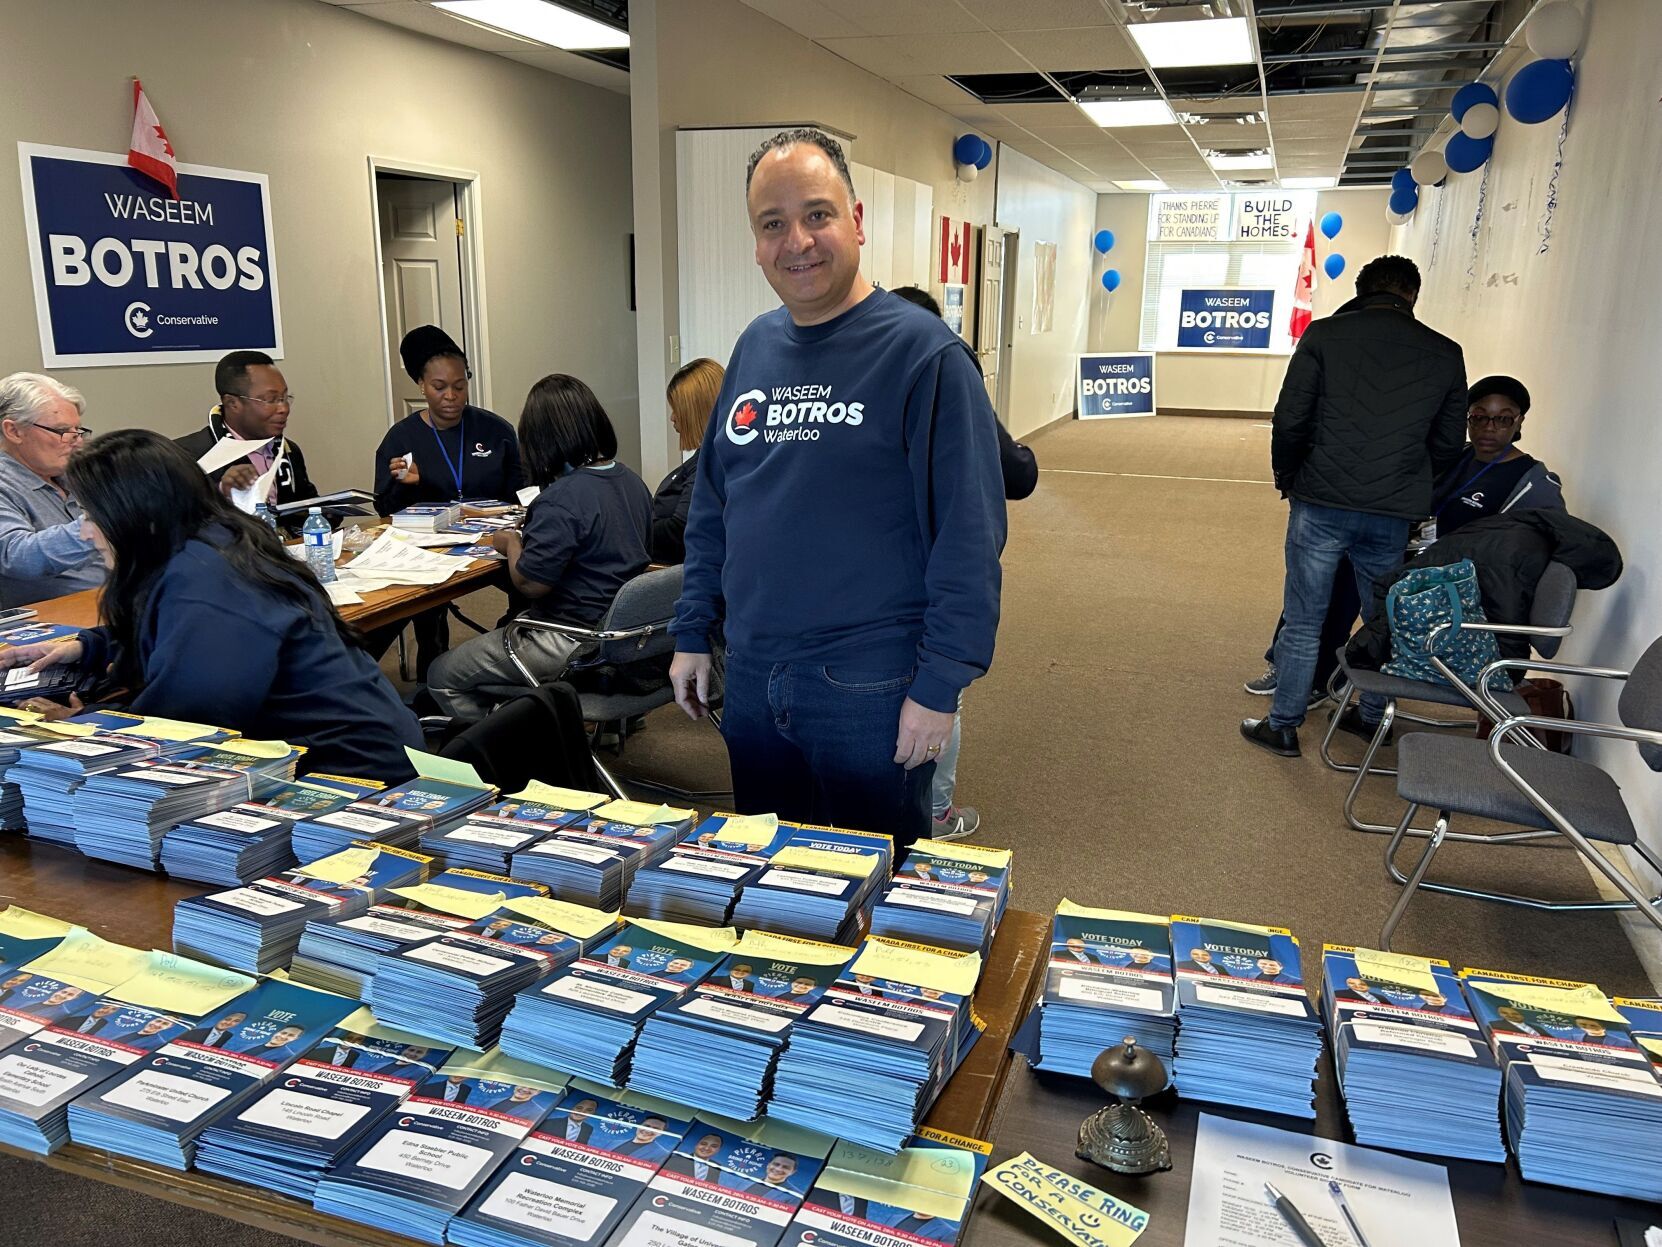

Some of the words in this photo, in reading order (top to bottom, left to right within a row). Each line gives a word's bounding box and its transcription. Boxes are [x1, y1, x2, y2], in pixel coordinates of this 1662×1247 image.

[104, 192, 214, 226] WASEEM
[1191, 200, 1219, 211] PIERRE
[1244, 199, 1293, 213] BUILD
[1173, 213, 1209, 224] STANDING
[1254, 213, 1281, 226] THE
[1160, 226, 1174, 237] FOR
[48, 234, 264, 291] BOTROS
[1205, 297, 1250, 308] WASEEM
[157, 314, 219, 326] Conservative
[1181, 311, 1270, 329] BOTROS
[1099, 364, 1134, 374] WASEEM
[771, 385, 832, 401] WASEEM
[1083, 378, 1151, 396] BOTROS
[766, 402, 865, 426] BOTROS
[764, 427, 820, 443] Waterloo
[930, 858, 954, 867] VOTE
[954, 861, 984, 871] TODAY
[1081, 932, 1108, 942] VOTE
[1108, 936, 1143, 947] TODAY
[1204, 943, 1233, 953] VOTE
[1233, 947, 1269, 957] TODAY
[770, 962, 798, 974] VOTE
[1471, 970, 1505, 978] CANADA
[268, 1009, 297, 1021] VOTE
[315, 1070, 350, 1084] WASEEM
[349, 1077, 383, 1090] BOTROS
[429, 1107, 465, 1122] WASEEM
[465, 1114, 501, 1129] BOTROS
[565, 1140, 578, 1148] VOTE
[925, 1129, 942, 1140] FOR
[940, 1134, 949, 1143] A
[949, 1136, 985, 1153] CHANGE.
[402, 1140, 420, 1148] Edna
[447, 1150, 469, 1160] Public
[418, 1150, 443, 1159] School
[734, 1147, 766, 1162] PIERRE
[551, 1146, 588, 1163] WASEEM
[588, 1157, 625, 1173] BOTROS
[536, 1160, 568, 1173] Conservative
[580, 1167, 601, 1177] CONTACT
[601, 1172, 613, 1180] INFO
[1010, 1163, 1044, 1190] FOR
[666, 1172, 680, 1180] CAST
[680, 1176, 695, 1185] YOUR
[694, 1180, 709, 1188] VOTE
[1021, 1158, 1096, 1202] PLEASE
[516, 1193, 552, 1207] Recreation
[553, 1203, 583, 1216] Complex
[524, 1188, 554, 1200] Waterloo
[554, 1196, 586, 1209] Memorial
[681, 1185, 722, 1205] WASEEM
[722, 1198, 760, 1215] BOTROS
[534, 1206, 552, 1215] David
[552, 1210, 570, 1219] Bauer
[668, 1202, 702, 1215] Conservative
[714, 1209, 737, 1220] CONTACT
[737, 1215, 752, 1223] INFO
[812, 1206, 826, 1214] CAST
[827, 1210, 842, 1219] YOUR
[842, 1214, 857, 1223] VOTE
[866, 1221, 882, 1231] APRIL
[1099, 1197, 1146, 1232] RING
[651, 1224, 664, 1232] The
[665, 1228, 689, 1240] Village
[830, 1221, 873, 1242] WASEEM
